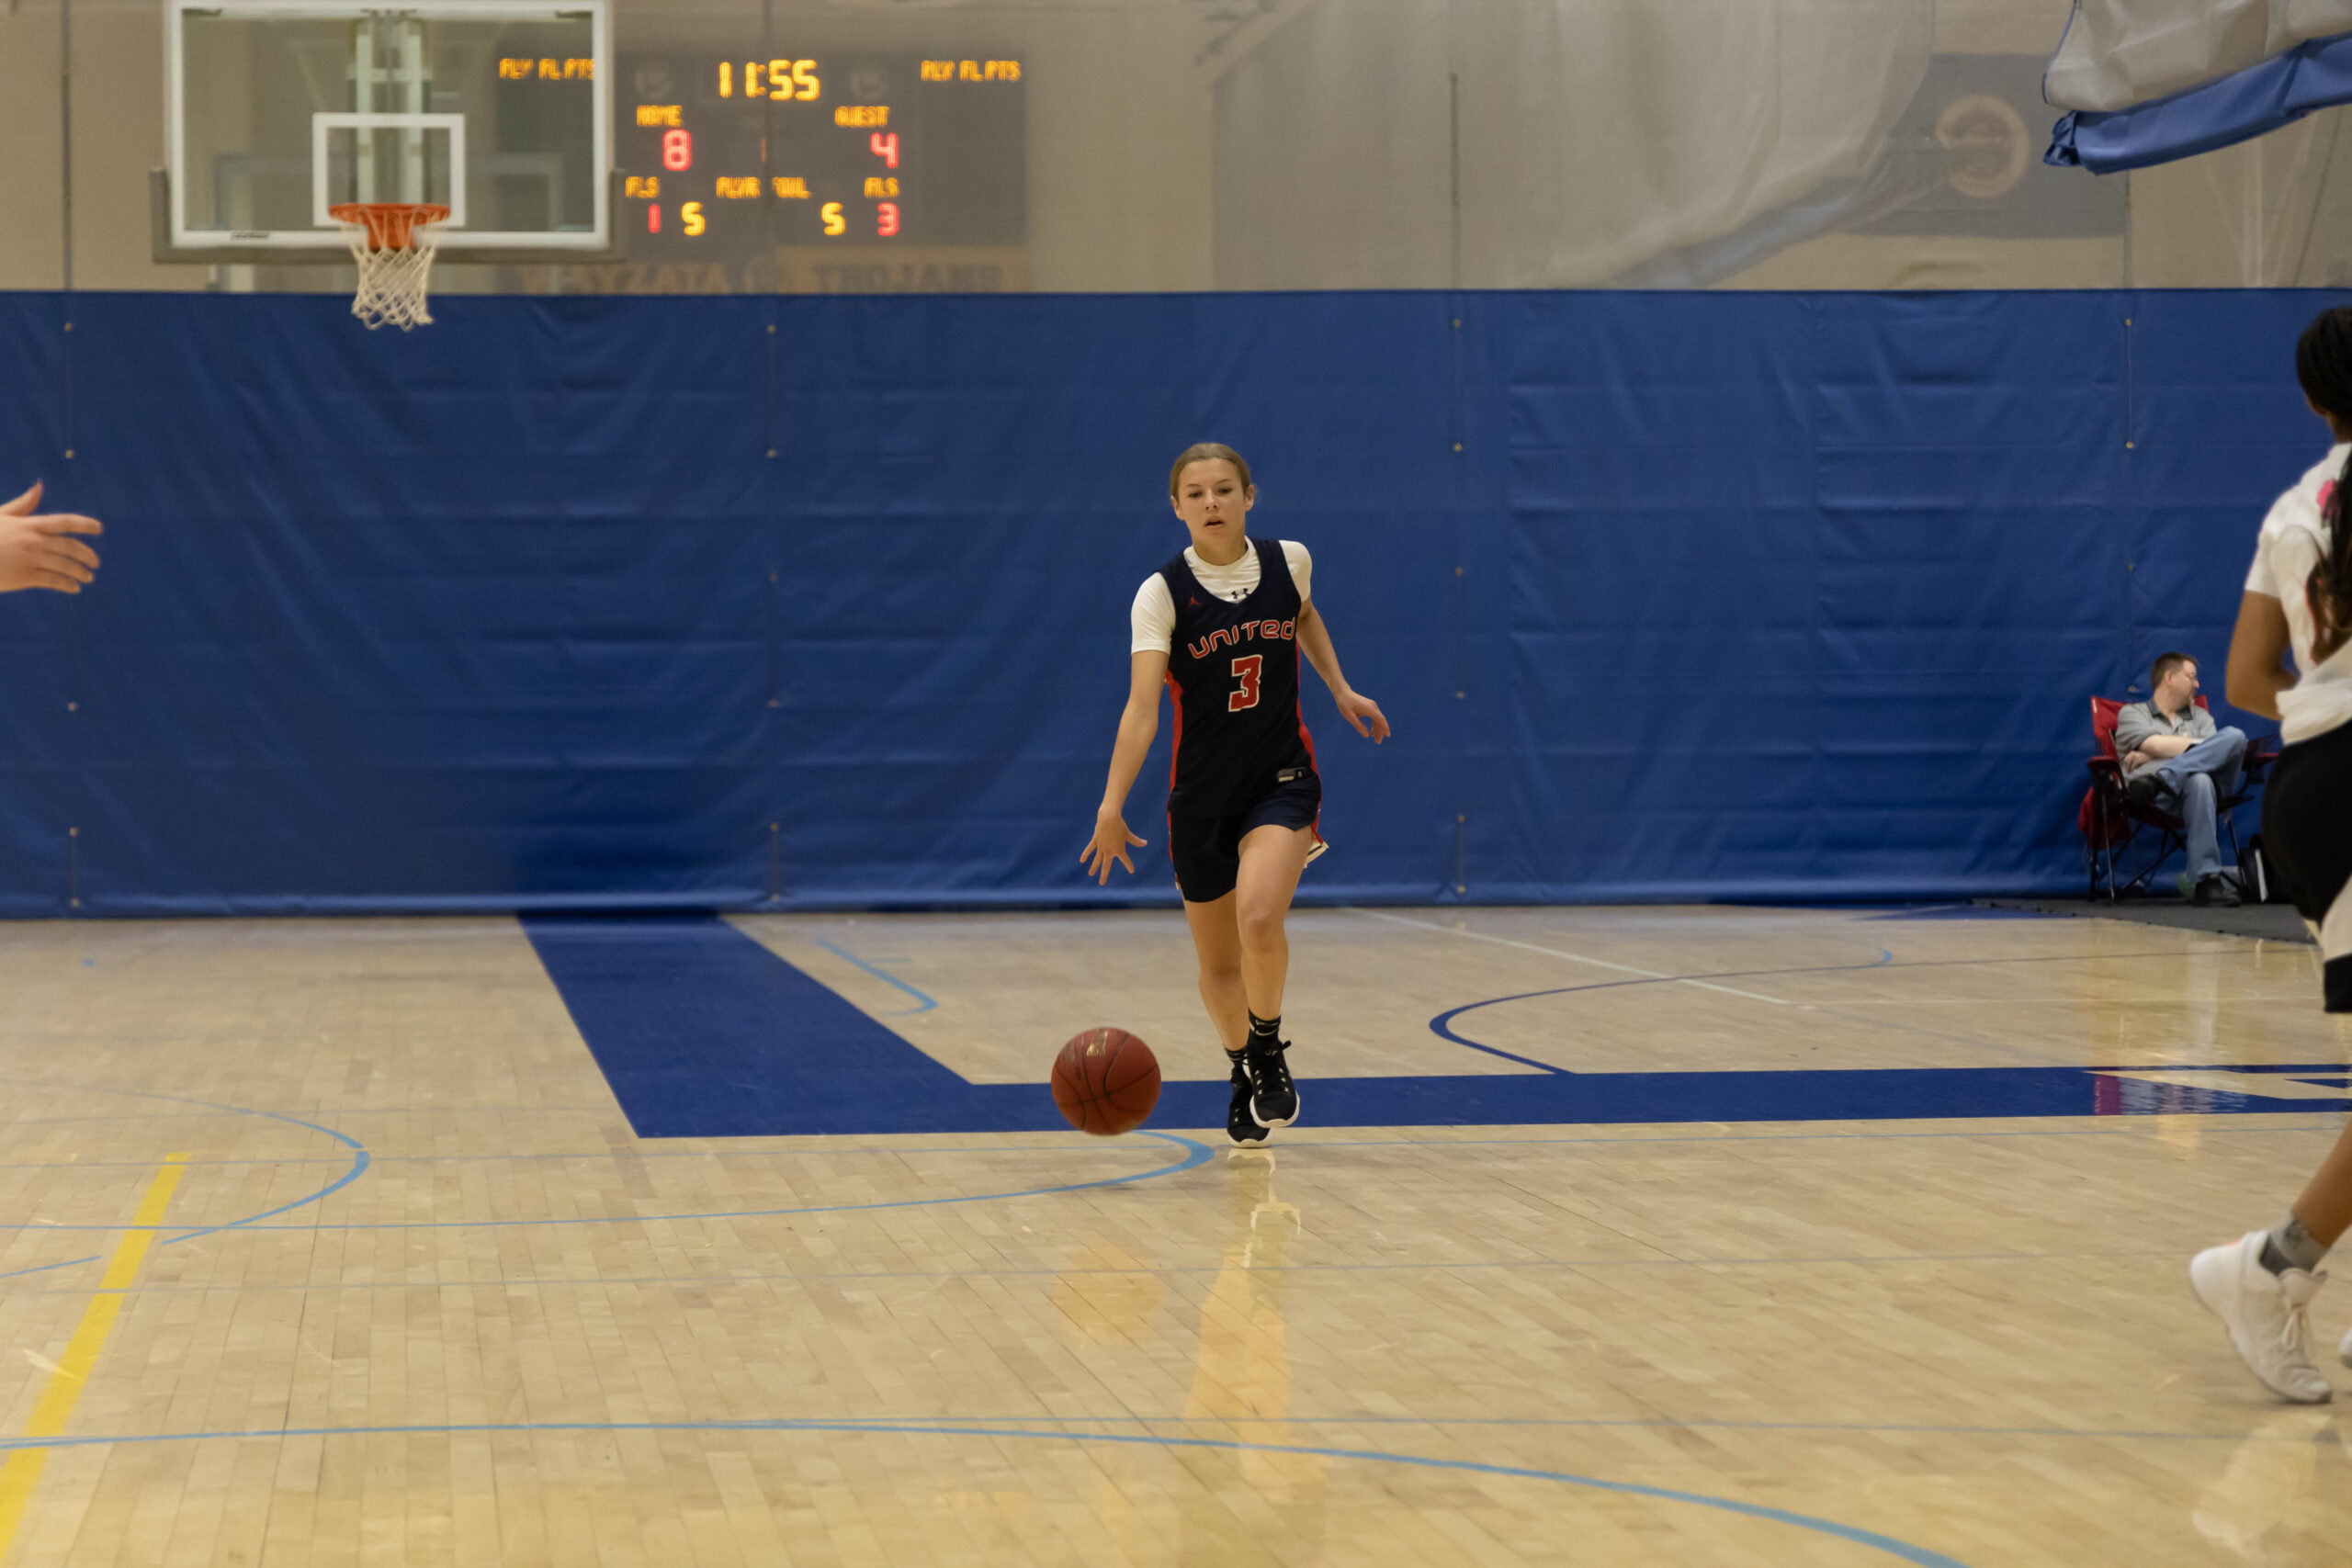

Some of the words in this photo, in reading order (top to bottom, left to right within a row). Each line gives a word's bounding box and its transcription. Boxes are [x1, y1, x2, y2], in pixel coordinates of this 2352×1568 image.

[718, 59, 821, 102] 11:55
[636, 105, 683, 128] HOME
[834, 106, 889, 128] GUEST
[662, 129, 693, 172] 8
[869, 132, 899, 169] 4
[648, 203, 662, 234] 1
[680, 201, 707, 237] 5
[820, 201, 847, 237] 5
[876, 201, 900, 237] 3
[1228, 654, 1263, 713] 3
